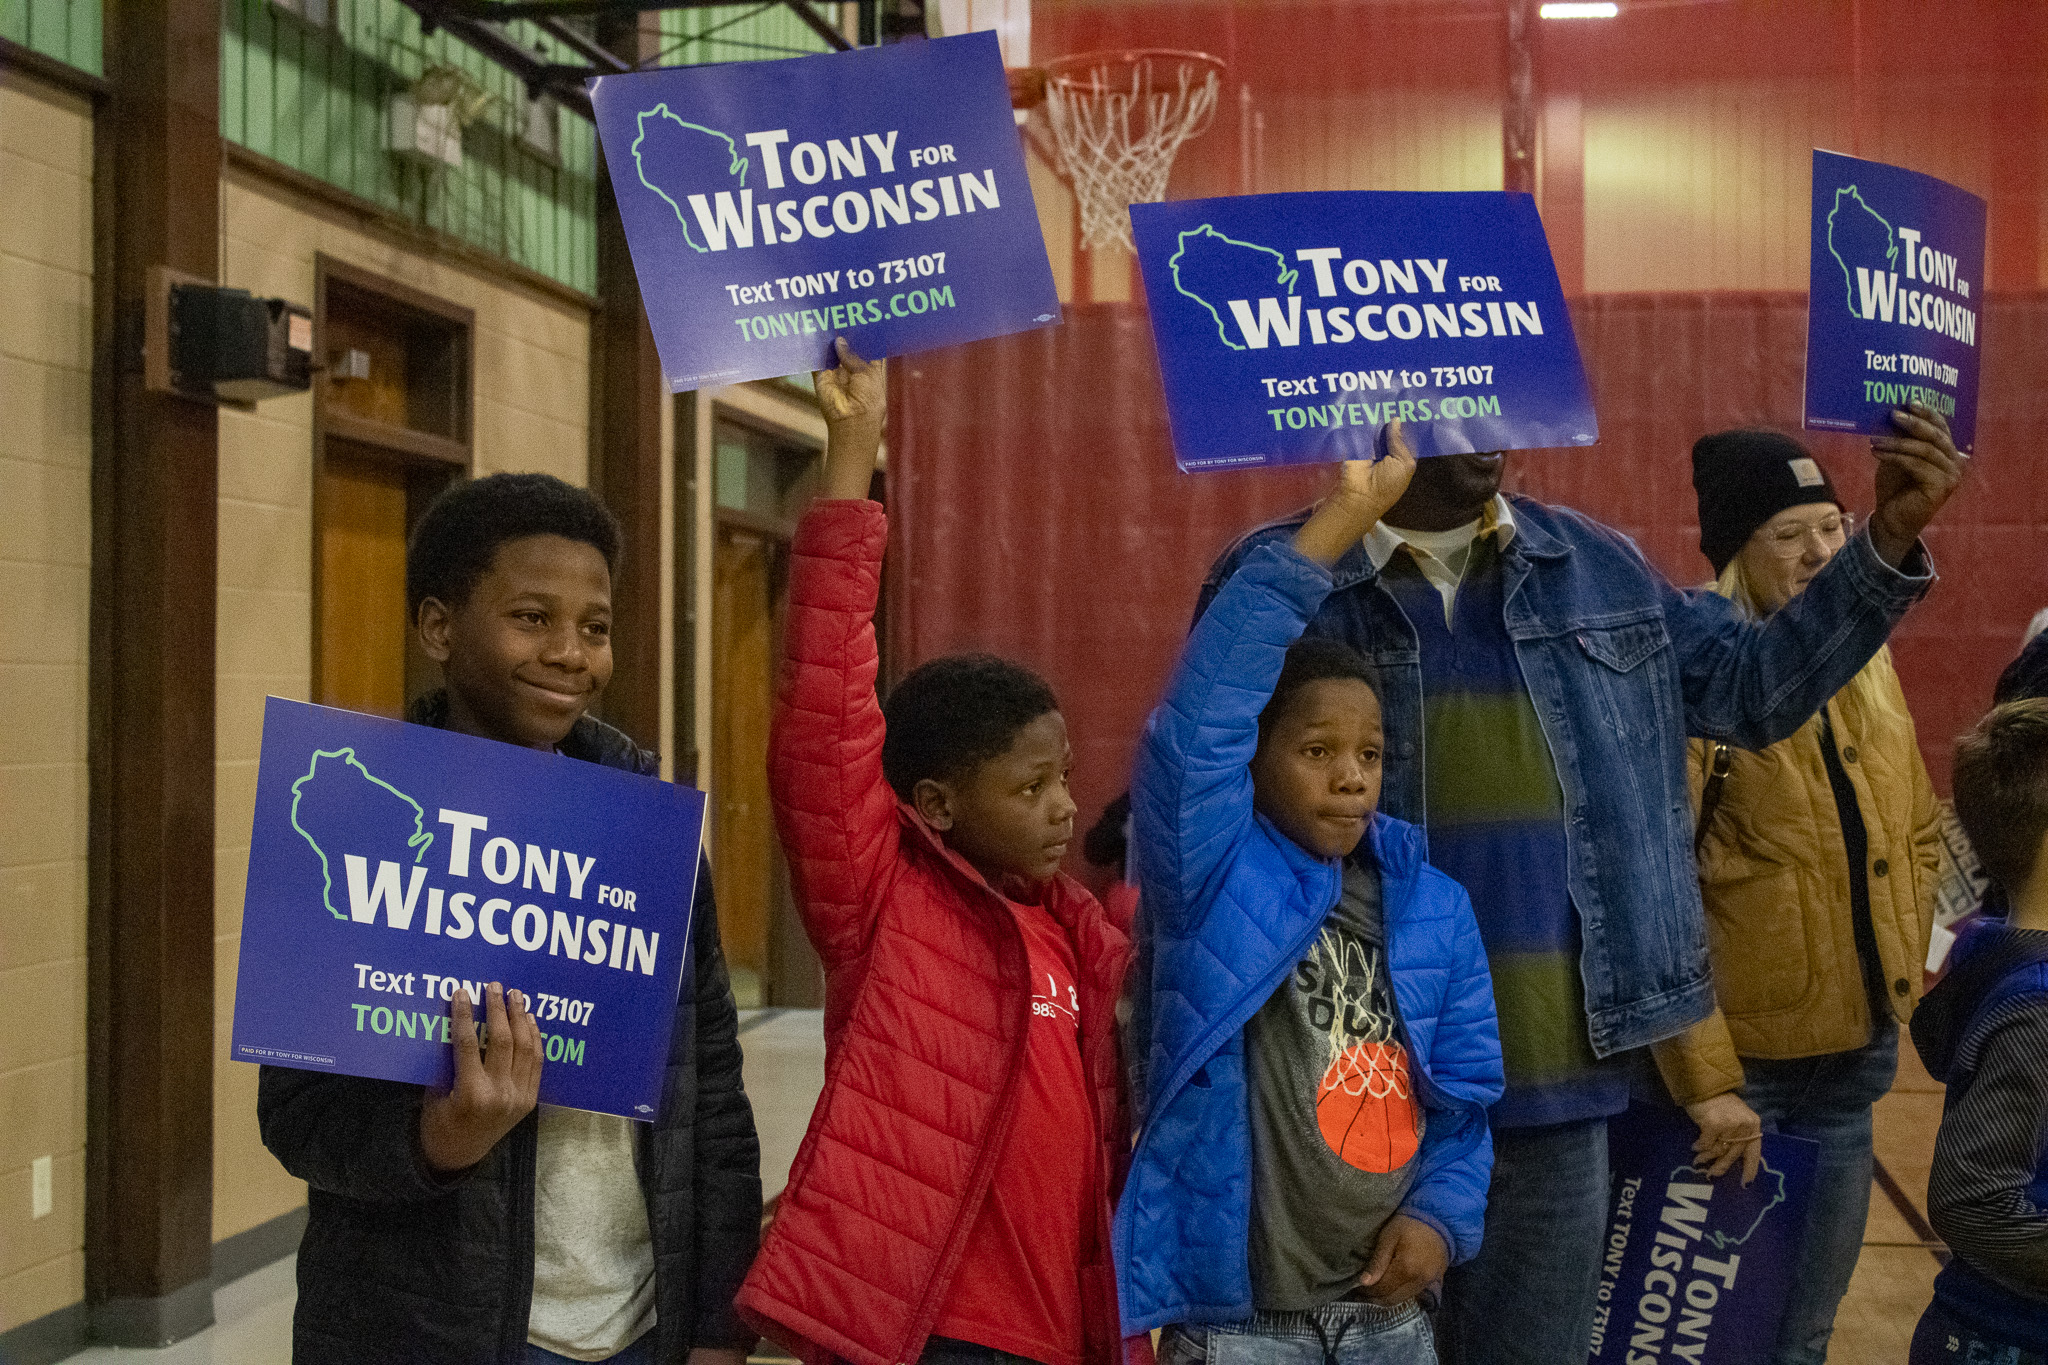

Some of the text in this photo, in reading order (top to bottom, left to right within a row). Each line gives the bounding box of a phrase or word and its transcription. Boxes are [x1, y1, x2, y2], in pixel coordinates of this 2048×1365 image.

[745, 129, 957, 190] TONY FOR
[688, 169, 1001, 252] WISCONSIN
[725, 252, 947, 306] Text TONY to 73107
[1296, 247, 1503, 298] TONY FOR
[1899, 227, 1970, 299] TONY FOR
[735, 285, 956, 343] TONYEVERS.COM
[1228, 295, 1544, 350] WISCONSIN
[1856, 266, 1976, 347] WISCONSIN
[1261, 365, 1494, 399] Text TONY to 73107
[1864, 350, 1897, 373] Text
[1900, 354, 1934, 378] TONY
[1934, 362, 1942, 381] to
[1267, 395, 1502, 432] TONYEVERS.COM
[438, 808, 637, 912] TONY FOR
[343, 853, 660, 976] WISCONSIN
[353, 963, 416, 996] Text
[422, 973, 491, 1006] TON
[536, 992, 595, 1027] 73107
[303, 1055, 333, 1064] WISCONSIN
[1590, 1177, 1643, 1356] Text TONY to 73107
[1670, 1254, 1741, 1365] TONY
